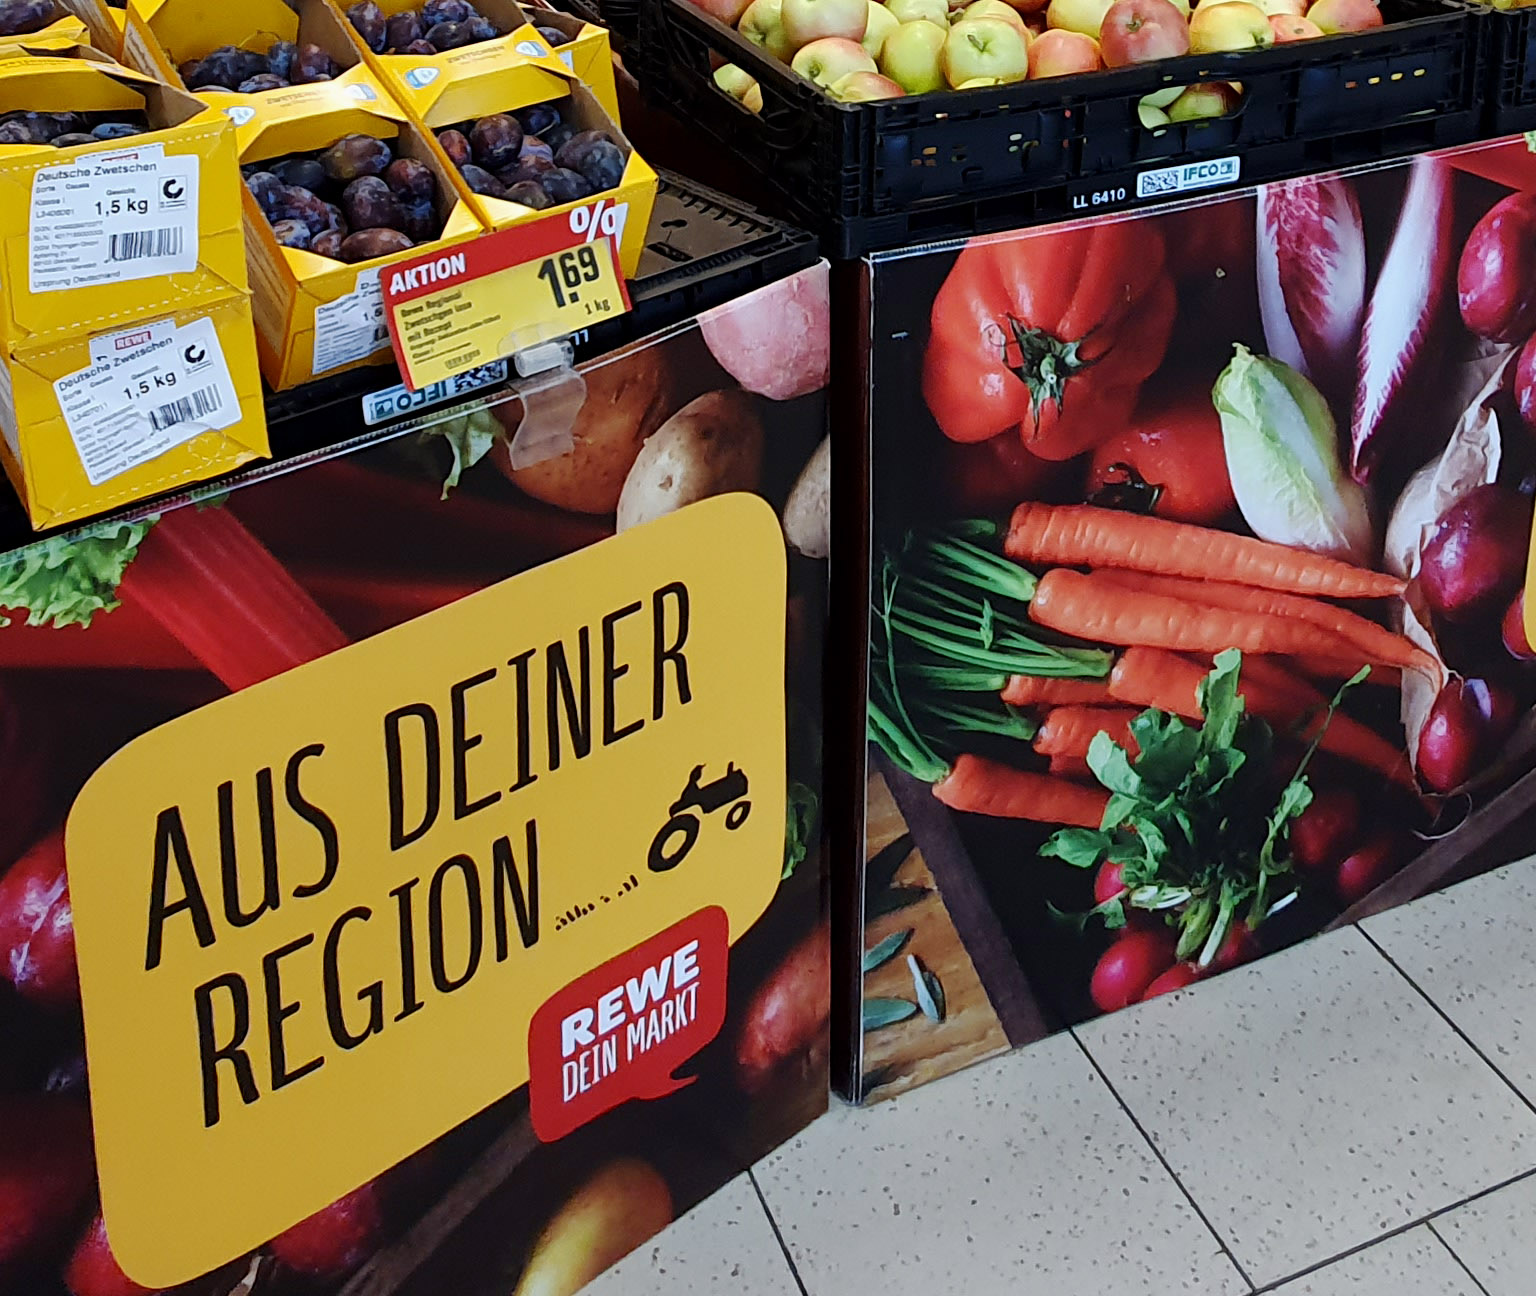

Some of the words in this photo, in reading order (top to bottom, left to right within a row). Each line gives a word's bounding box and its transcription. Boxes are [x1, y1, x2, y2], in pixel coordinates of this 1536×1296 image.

[37, 168, 91, 182] Deutsche
[94, 163, 157, 175] Zwetschen
[1184, 164, 1218, 181] IFCO
[95, 201, 121, 217] 1,5
[127, 198, 148, 214] kg
[1073, 196, 1088, 208] LL
[1092, 188, 1125, 205] 6410
[390, 253, 466, 295] AKTION
[594, 299, 611, 313] kg
[115, 331, 151, 350] REWE
[59, 363, 111, 391] Deutsche
[114, 337, 173, 367] Zwetschen
[123, 380, 149, 399] 1,5
[154, 371, 177, 388] kg
[144, 742, 342, 971] AUS
[383, 580, 693, 854] DEINER
[193, 819, 541, 1128] REGION
[560, 939, 701, 1058] REWE
[561, 1038, 618, 1105] DEIN
[626, 981, 700, 1065] MARKT
